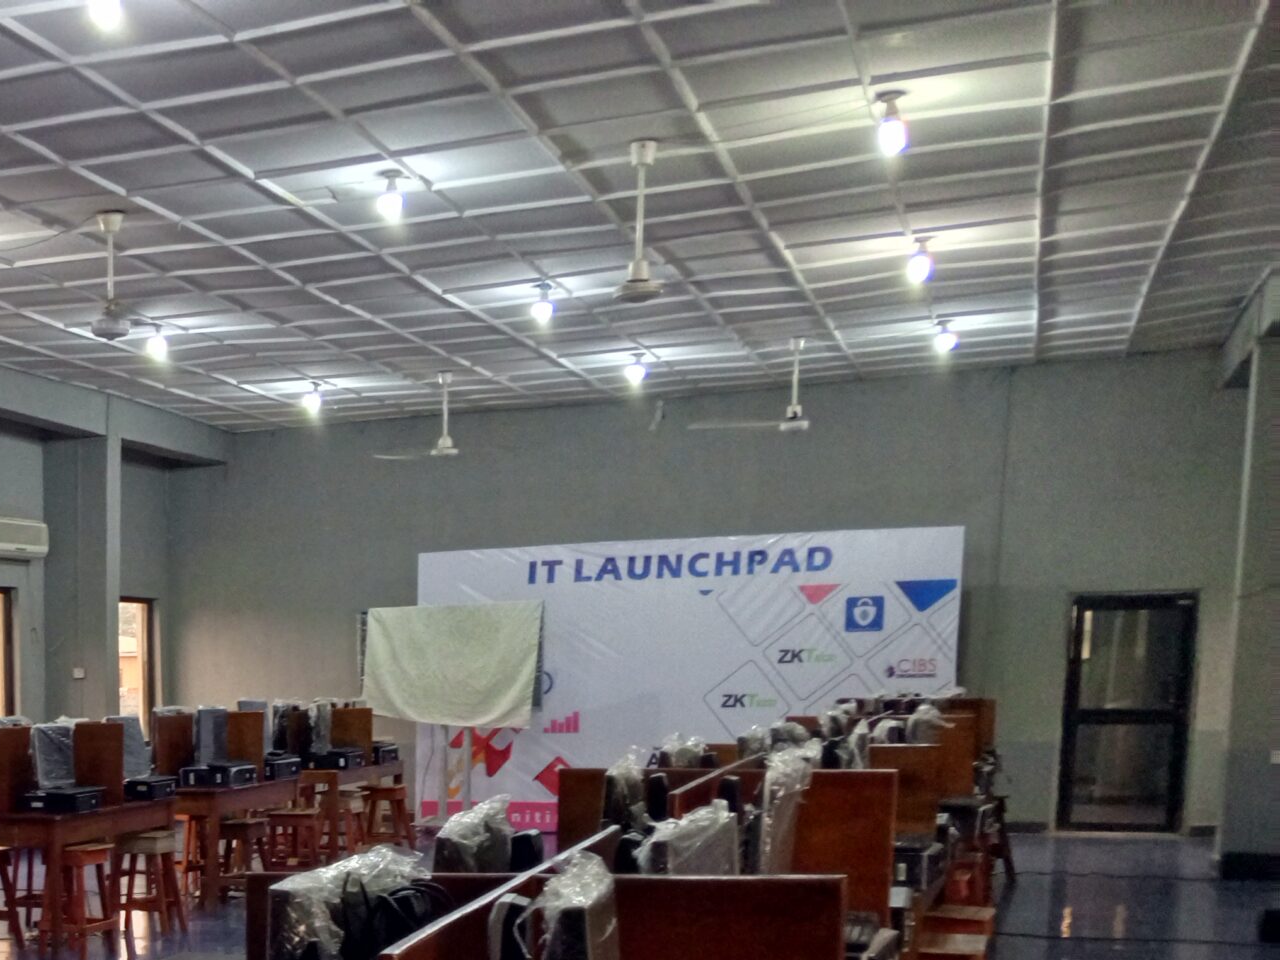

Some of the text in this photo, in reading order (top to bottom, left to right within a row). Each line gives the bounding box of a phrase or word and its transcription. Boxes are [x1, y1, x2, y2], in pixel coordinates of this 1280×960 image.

[527, 546, 833, 585] IT LAUNCHPAD
[777, 648, 836, 664] ZKT
[897, 658, 937, 673] CIBS
[720, 694, 776, 708] ZKT
